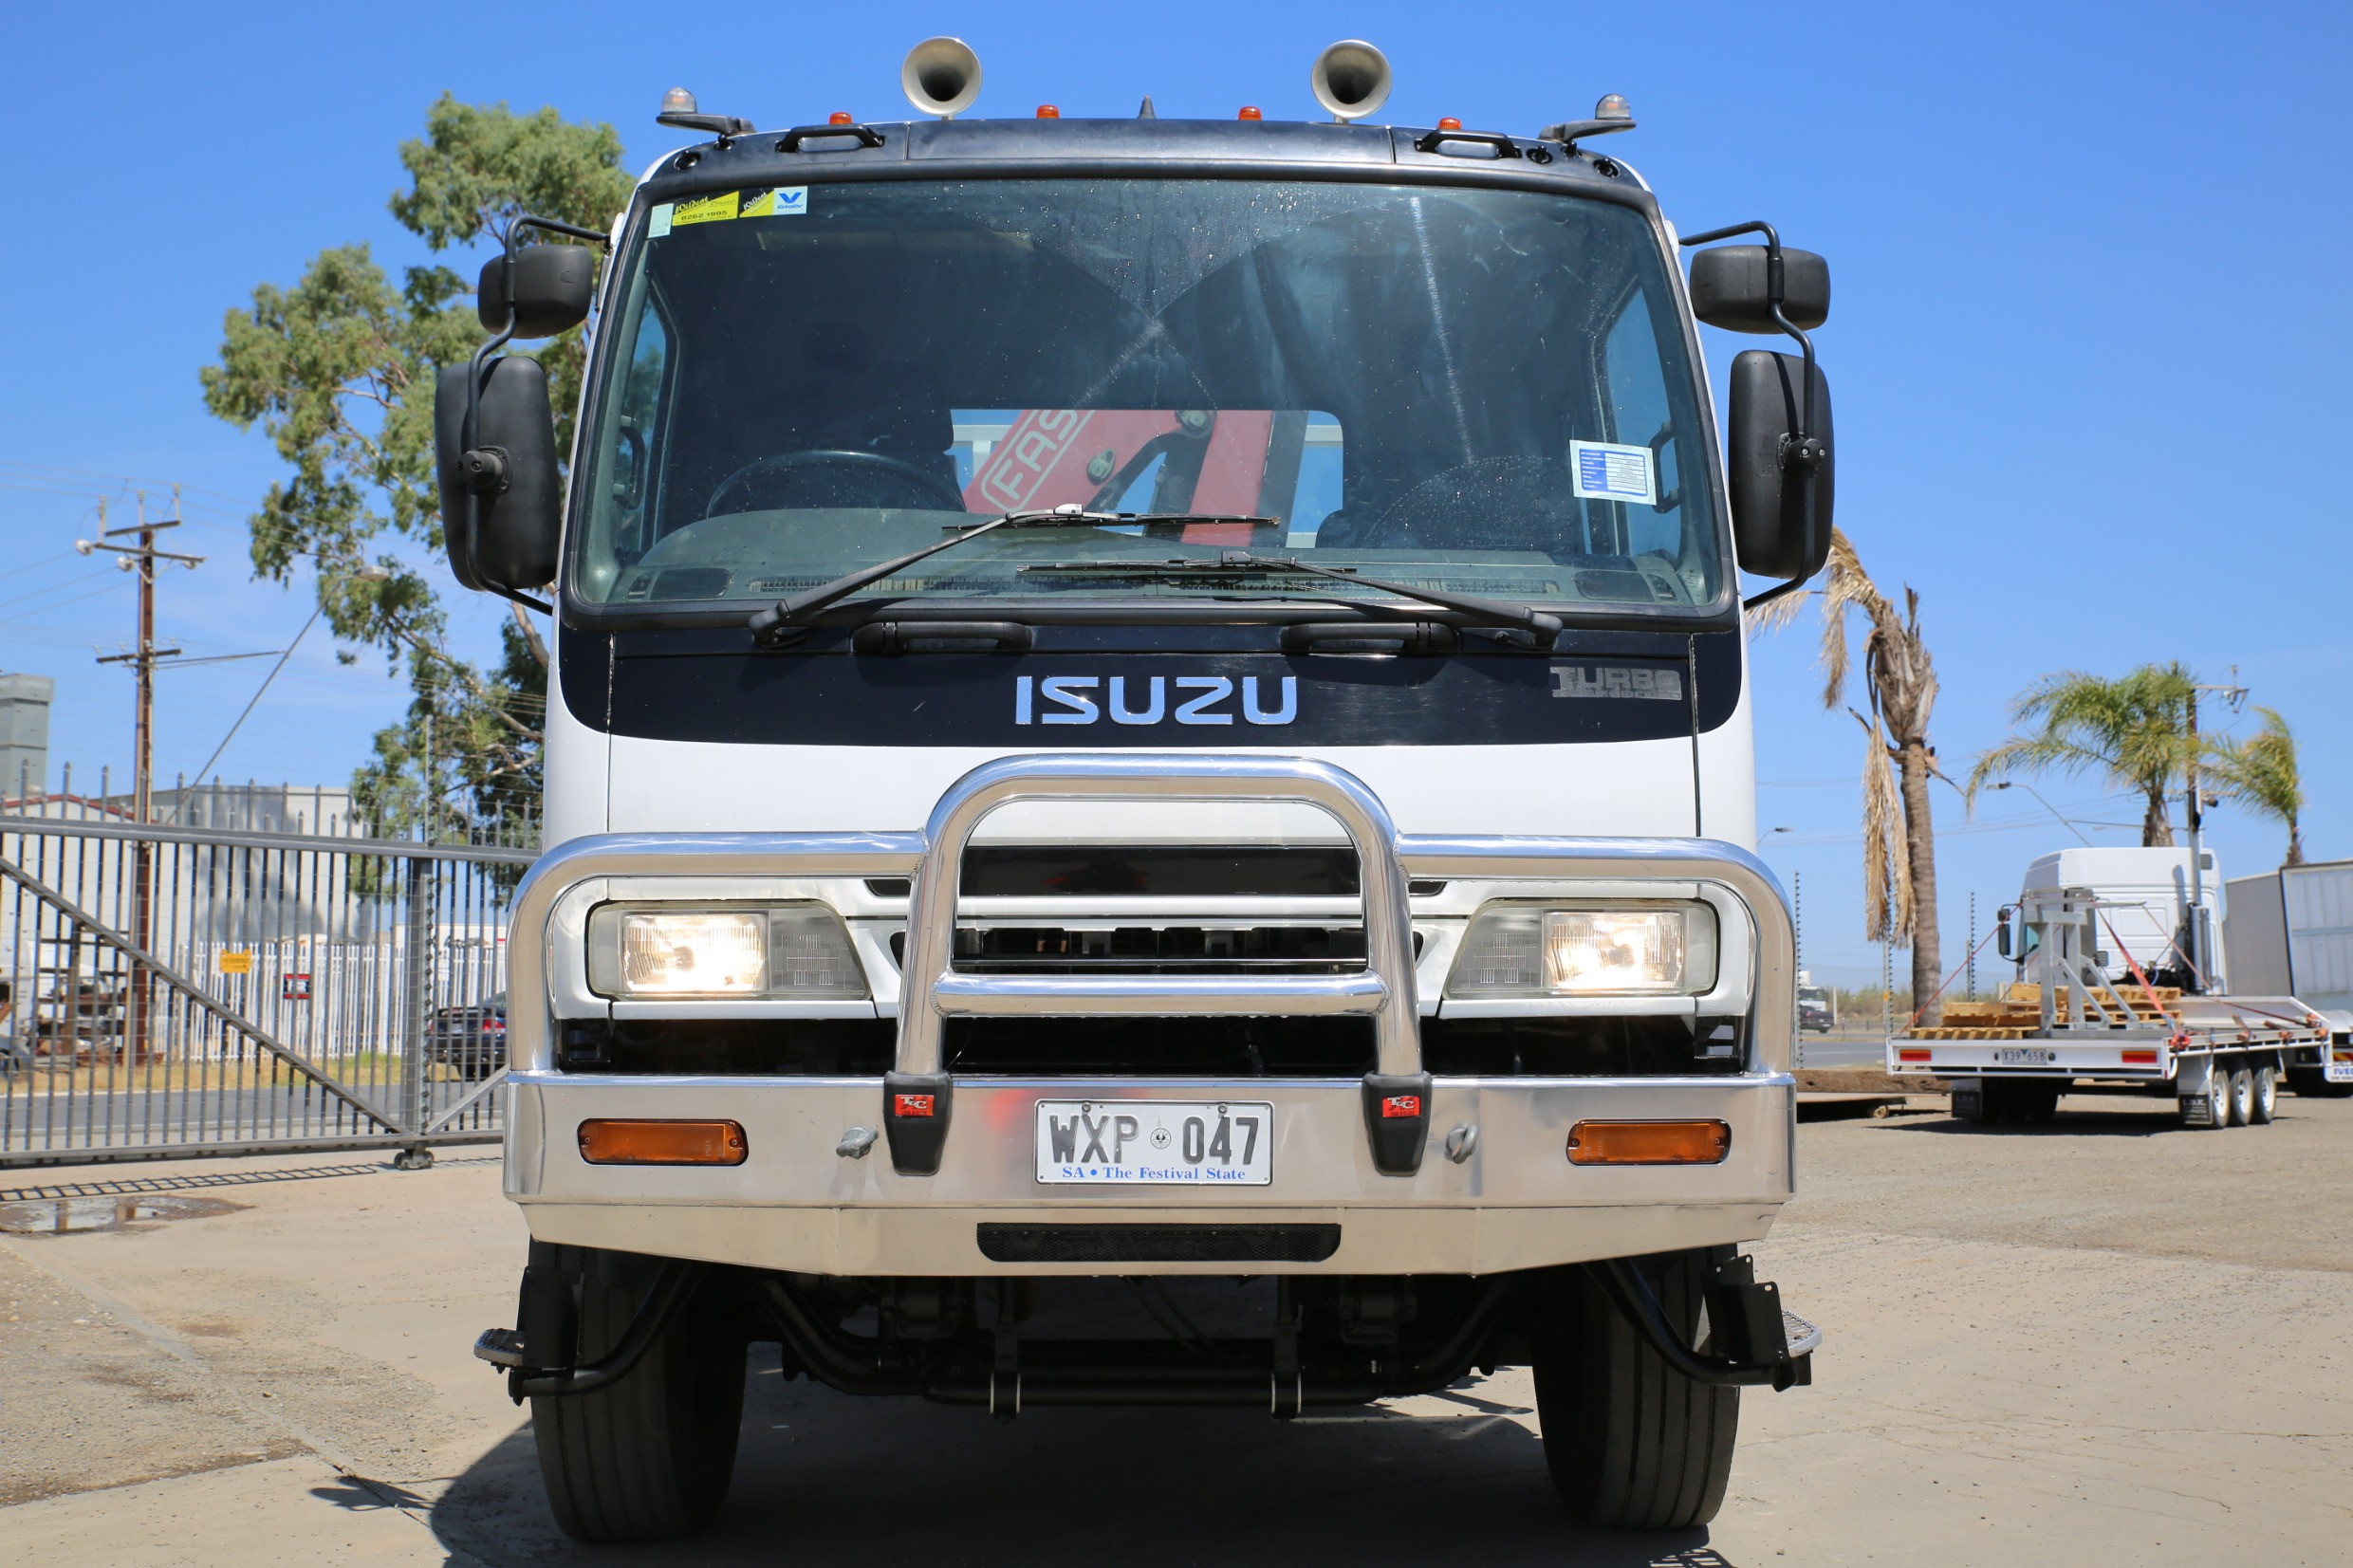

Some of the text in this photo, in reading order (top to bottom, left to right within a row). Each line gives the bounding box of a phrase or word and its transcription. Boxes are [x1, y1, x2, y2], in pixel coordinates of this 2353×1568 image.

[1015, 676, 1297, 725] ISUZU
[1049, 1115, 1259, 1165] WXP 047
[1062, 1167, 1246, 1179] SA The Festival State
